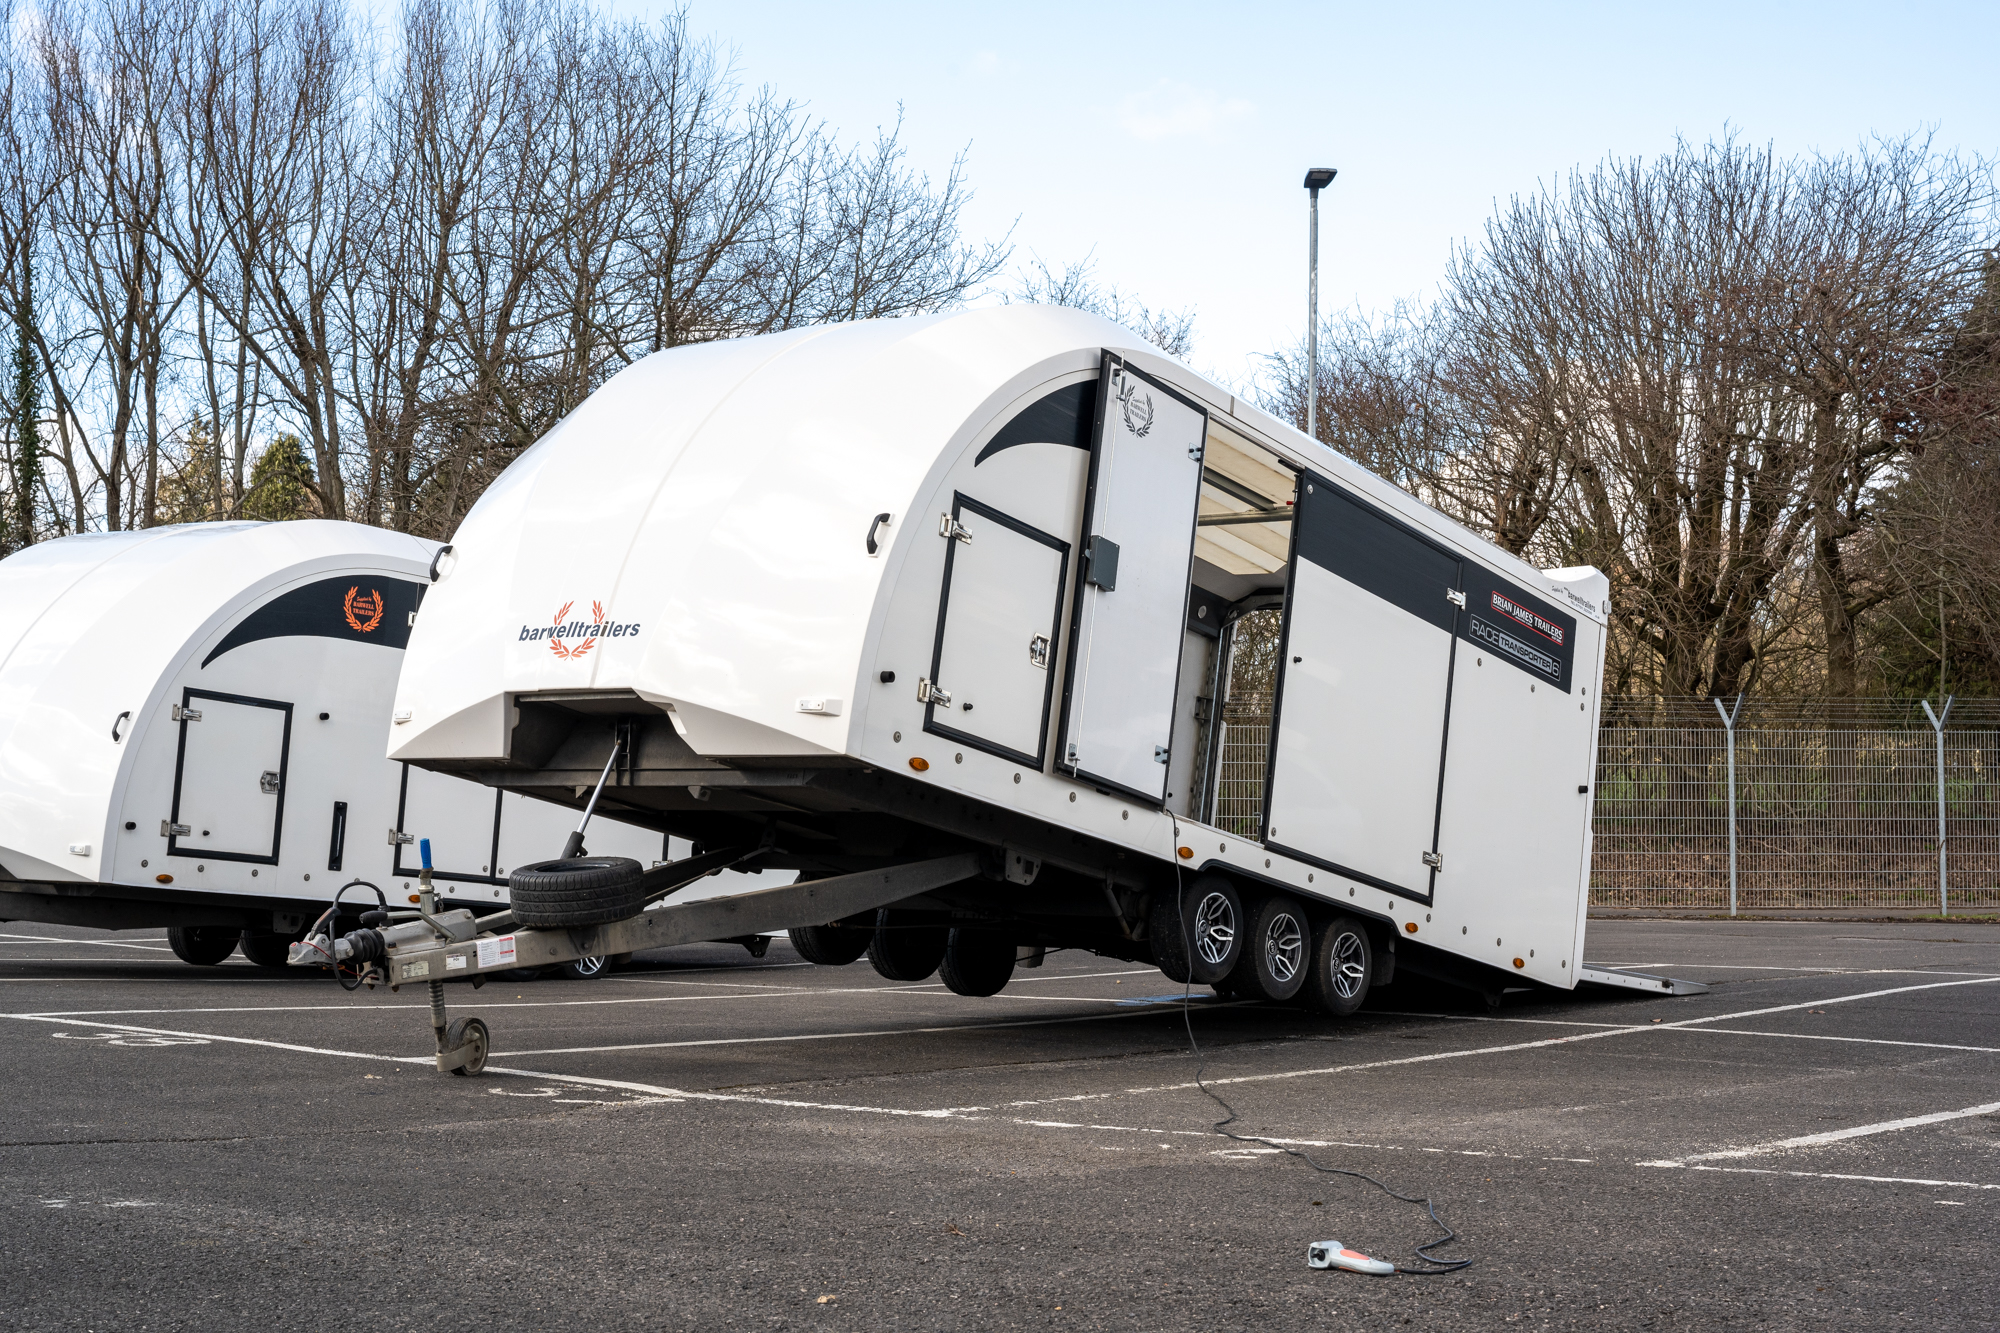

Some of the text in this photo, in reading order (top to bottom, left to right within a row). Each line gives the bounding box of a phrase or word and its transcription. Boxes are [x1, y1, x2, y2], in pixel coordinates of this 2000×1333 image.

[353, 607, 375, 616] TRAILERS
[1492, 593, 1513, 613] BRIAN
[1512, 604, 1534, 624] JAMES
[1533, 616, 1563, 640] TRAILERS
[1471, 619, 1500, 645] RACE
[1499, 636, 1552, 671] TRANSPORTER
[1552, 662, 1560, 676] 6
